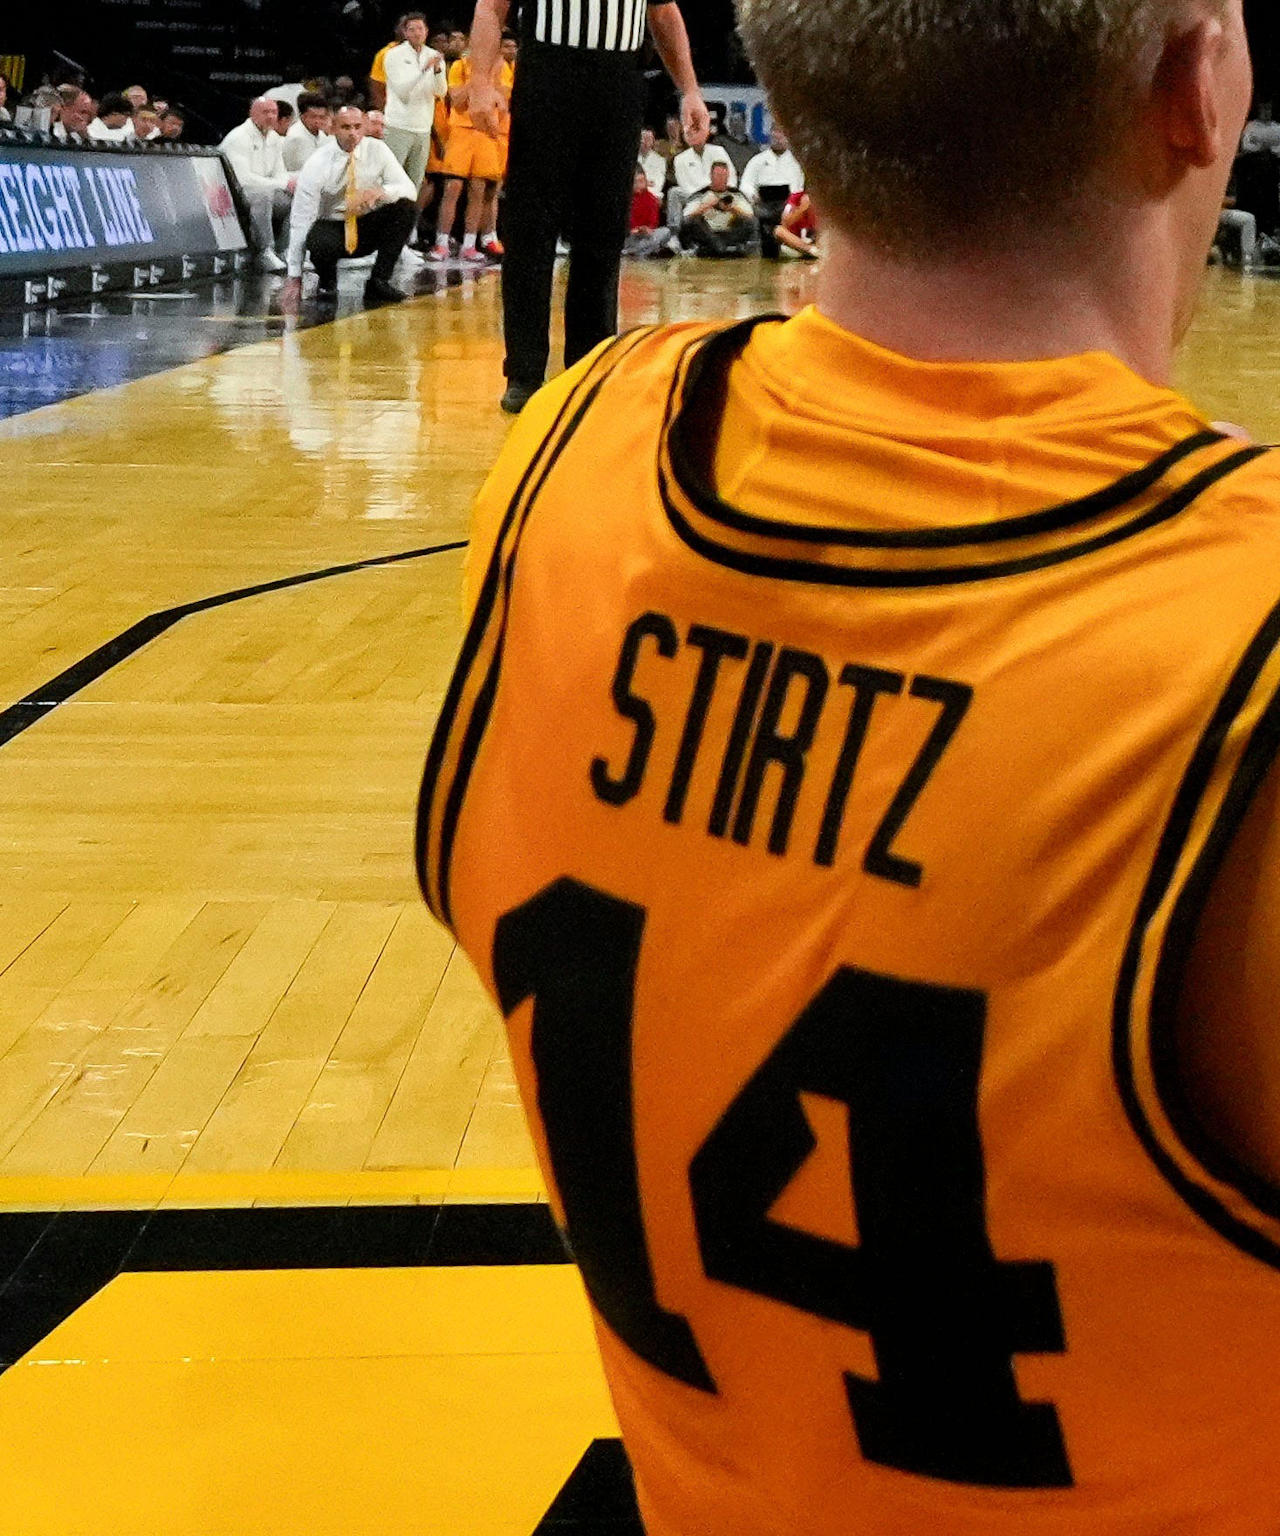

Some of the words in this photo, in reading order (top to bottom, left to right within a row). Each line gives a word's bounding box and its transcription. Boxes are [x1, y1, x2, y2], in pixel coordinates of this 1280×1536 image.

[84, 166, 154, 246] LINE
[589, 611, 974, 887] STIRTZ
[493, 875, 1073, 1488] 14
